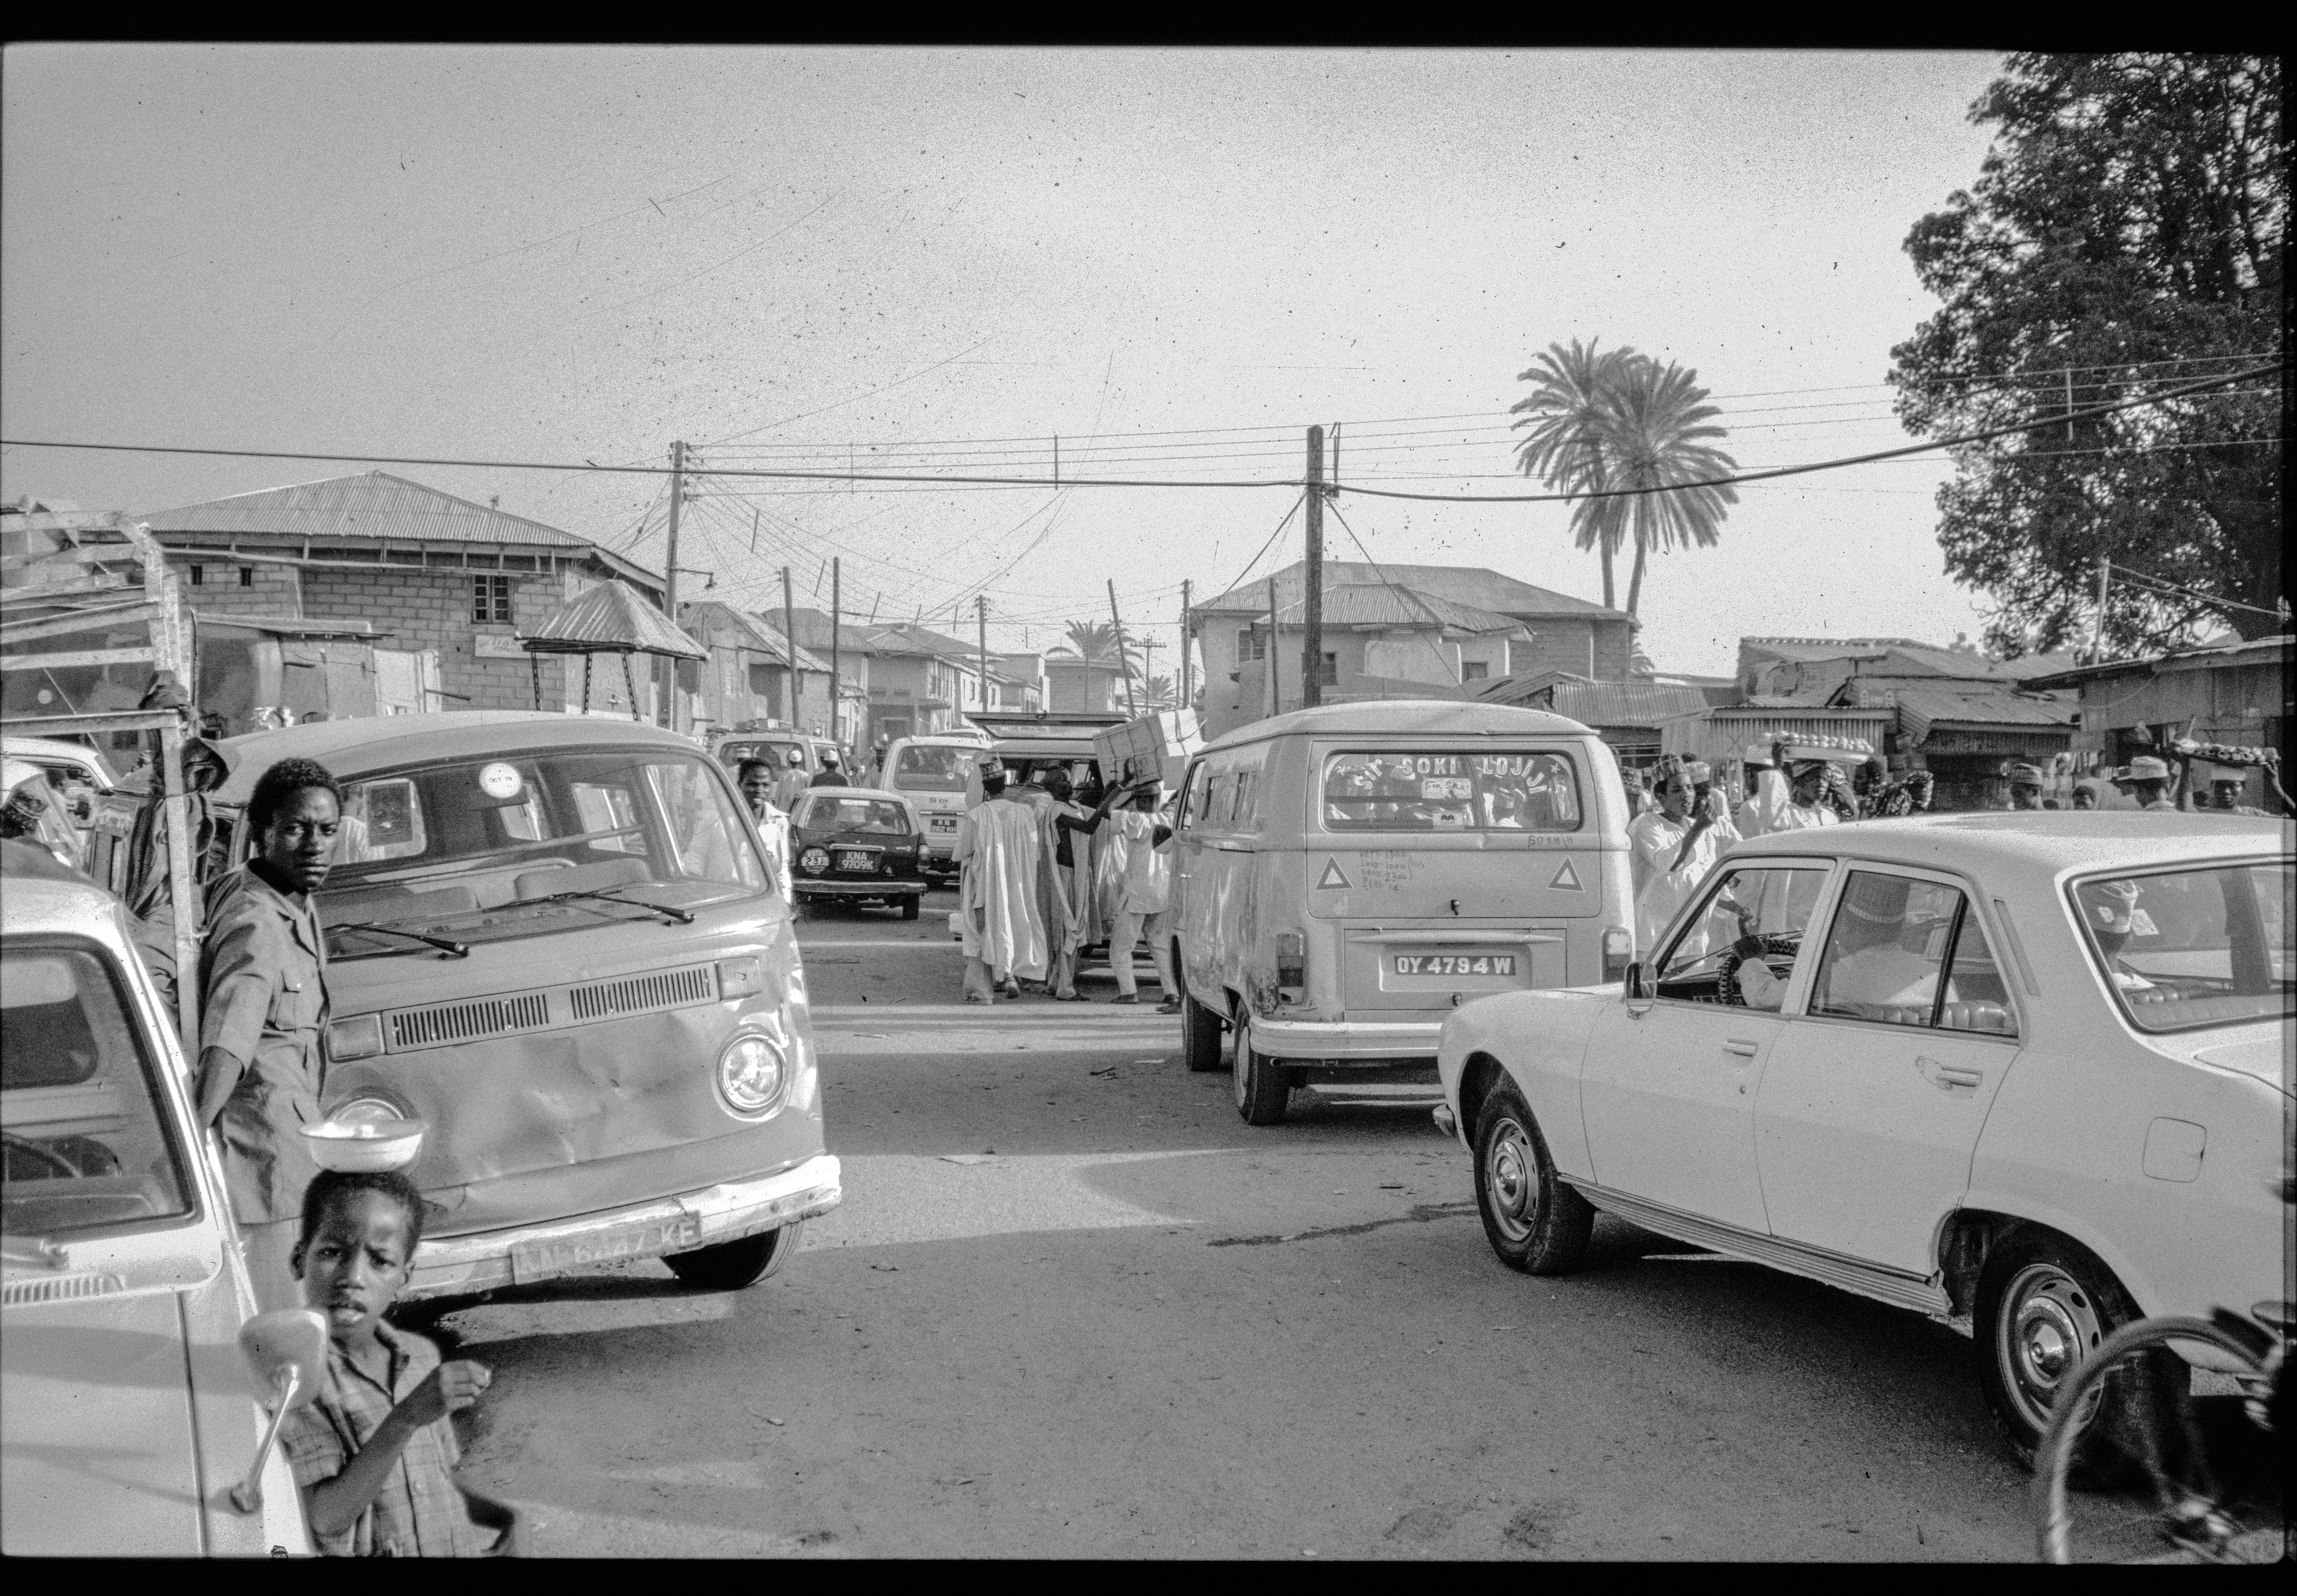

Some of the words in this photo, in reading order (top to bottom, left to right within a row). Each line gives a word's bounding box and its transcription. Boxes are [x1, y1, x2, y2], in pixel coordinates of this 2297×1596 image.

[1402, 757, 1455, 774] SOKI
[1483, 757, 1547, 793] LOJIJI
[1528, 835, 1544, 845] 60
[846, 851, 868, 861] KNA
[842, 859, 874, 870] 9709K
[1386, 862, 1407, 870] 1000
[1384, 872, 1407, 881] 2300
[1397, 956, 1423, 973] OY
[1427, 956, 1489, 974] 4794
[1493, 957, 1511, 974] W
[660, 1221, 698, 1246] KE
